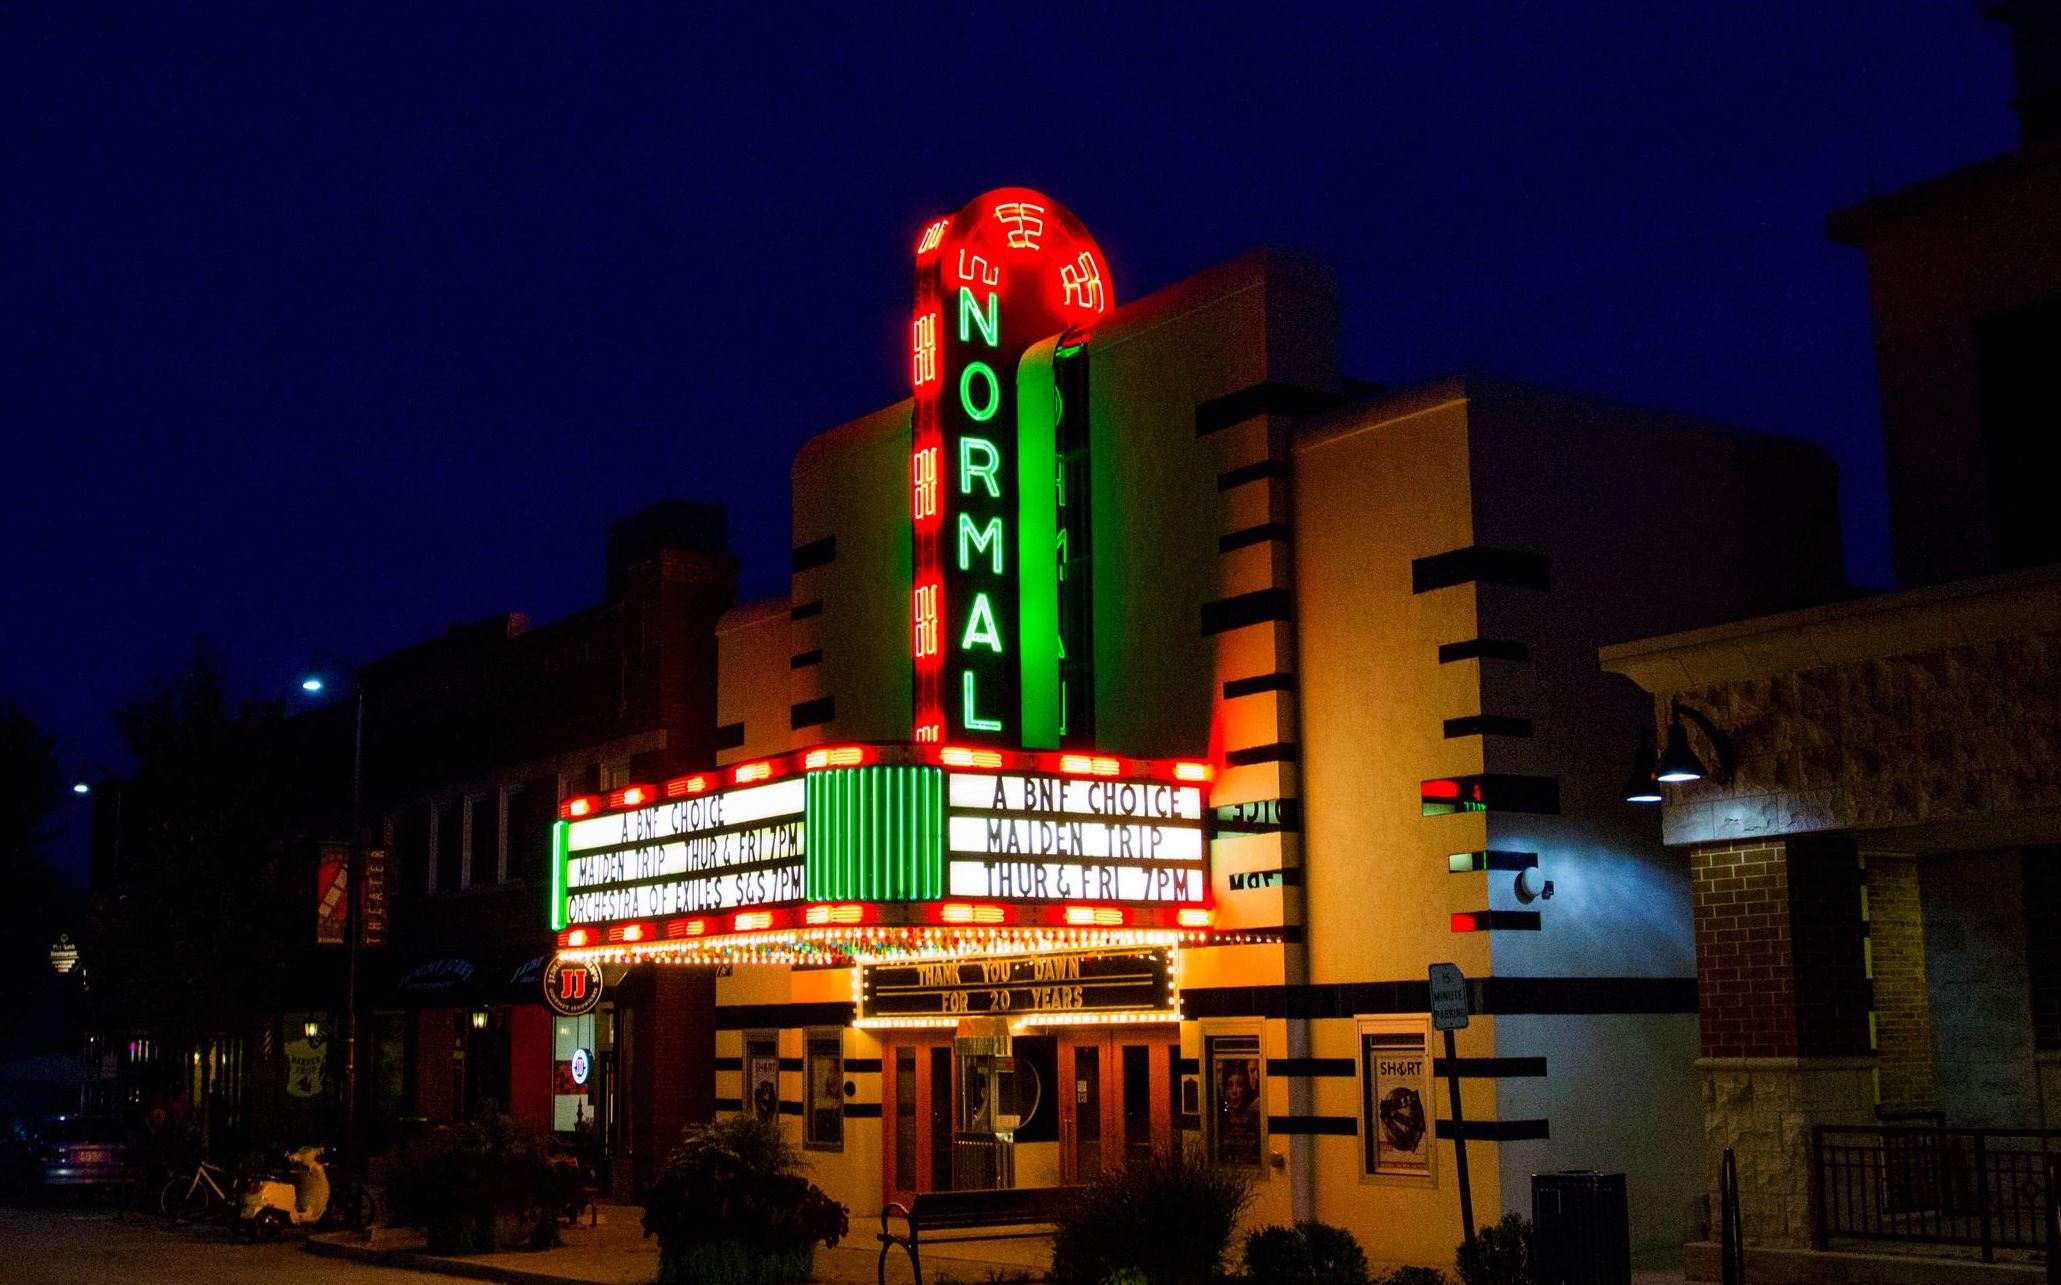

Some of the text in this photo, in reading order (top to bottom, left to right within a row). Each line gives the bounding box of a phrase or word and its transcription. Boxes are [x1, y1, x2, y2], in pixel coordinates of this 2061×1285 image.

[959, 286, 1001, 731] NORMAL
[992, 775, 1182, 818] A BNF CHOICE
[621, 813, 628, 843] A
[671, 795, 725, 834] CHOICE
[986, 818, 1162, 859] MAIDEN TRIP
[579, 850, 625, 888] MAIDEN
[636, 845, 665, 880] TRIP
[685, 835, 718, 873] THUR
[740, 827, 762, 863] FRI
[770, 822, 798, 861] 7PM
[569, 887, 639, 923] ORCHESTRA
[649, 883, 668, 915] OF
[675, 876, 722, 913] EXILES
[772, 865, 801, 902] 7PM
[984, 860, 1189, 901] THUR & FRI 7PM
[561, 969, 586, 999] JJ
[917, 957, 1079, 986] THANK YOU DAWN
[942, 986, 1083, 1012] FOR 20 YEARS
[1434, 990, 1464, 1001] MINUTE
